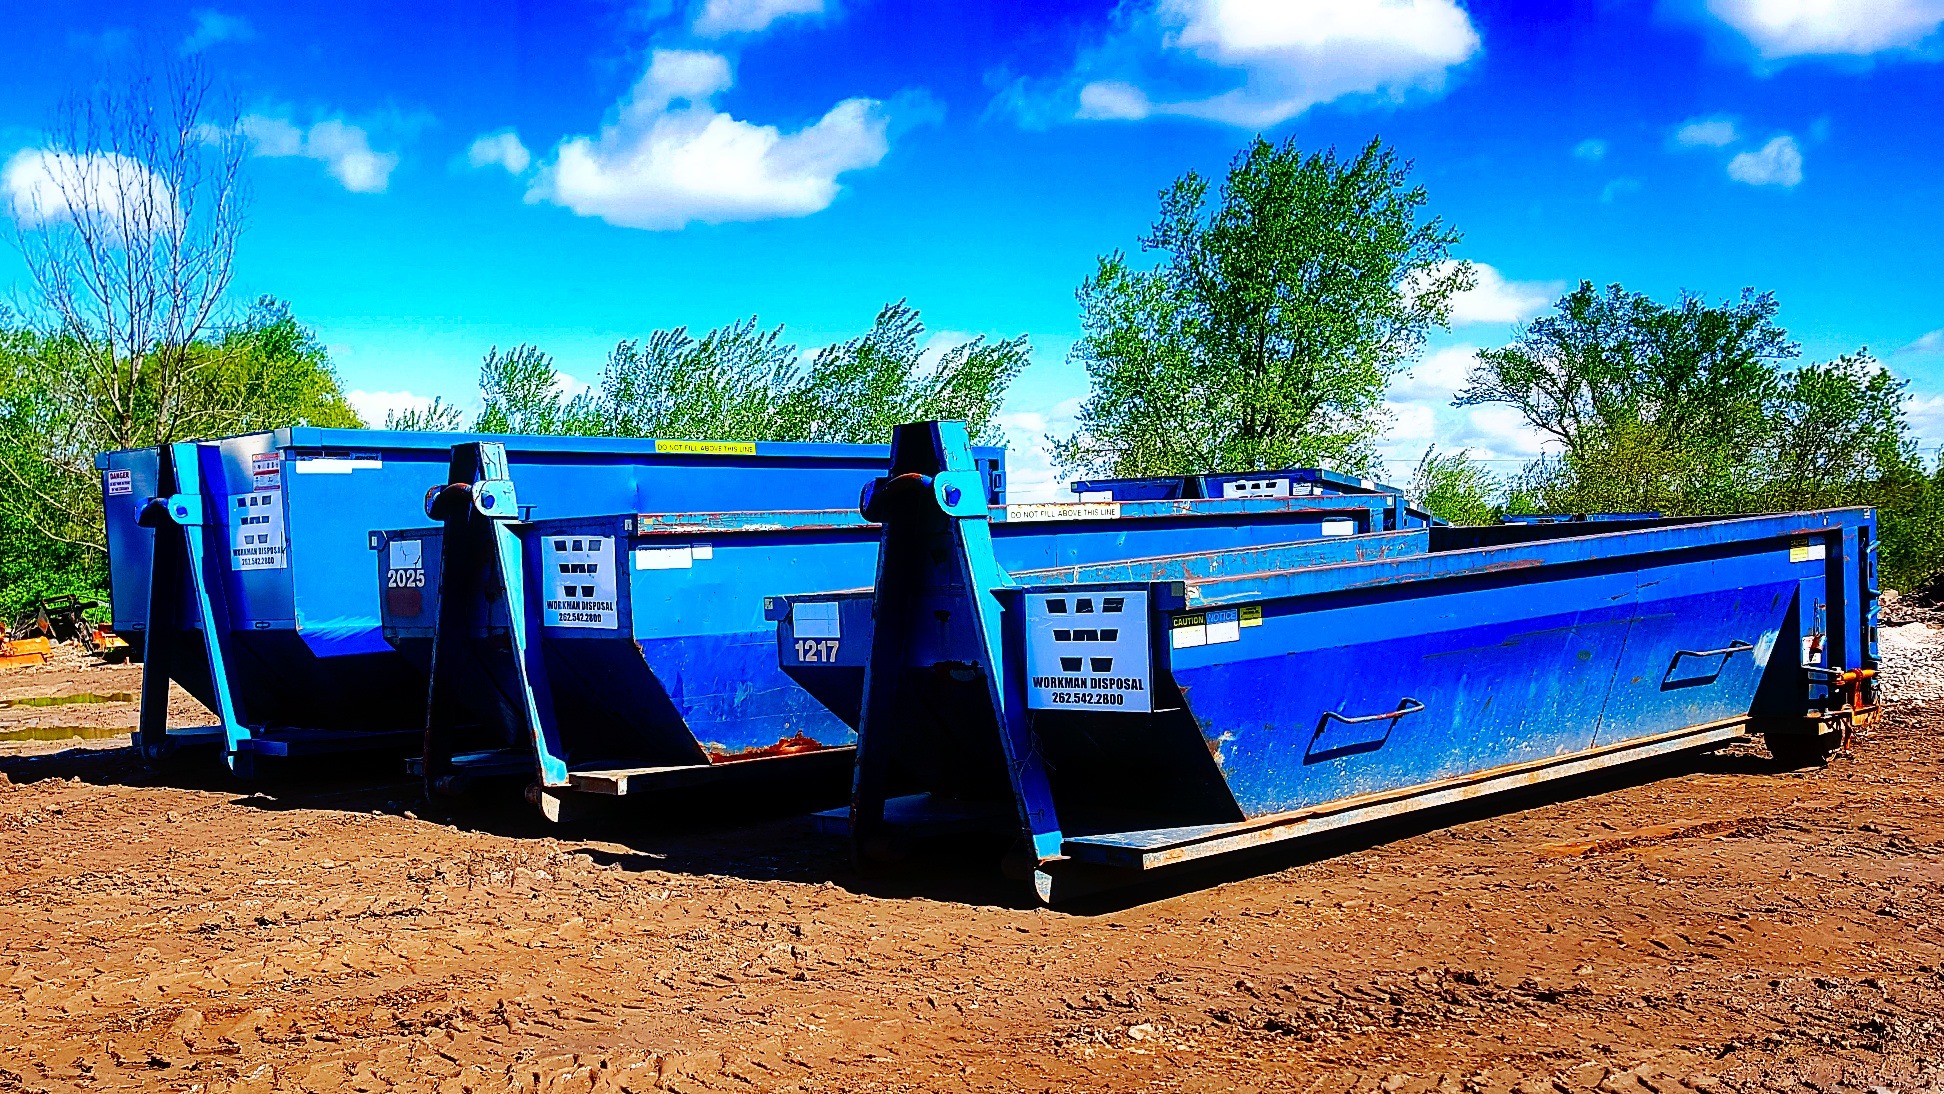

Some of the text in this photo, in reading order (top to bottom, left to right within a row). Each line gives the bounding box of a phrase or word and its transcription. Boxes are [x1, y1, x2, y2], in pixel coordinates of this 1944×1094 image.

[684, 444, 699, 452] FILL
[700, 444, 722, 452] ABOVE
[723, 445, 738, 453] THIS
[109, 471, 130, 480] DANGER
[1010, 508, 1116, 519] DO NOT FILL ABOVE THIS LINE
[387, 569, 425, 588] 2025
[546, 600, 614, 611] WORKMAN DISPOSAL
[558, 612, 602, 623] 262.542.2800
[1173, 616, 1204, 627] CAUTION
[1208, 611, 1237, 622] NOTICE
[794, 639, 840, 663] 1217
[1032, 676, 1145, 691] WORKMAN DISPOSAL
[1051, 692, 1124, 706] 262.542.2800
